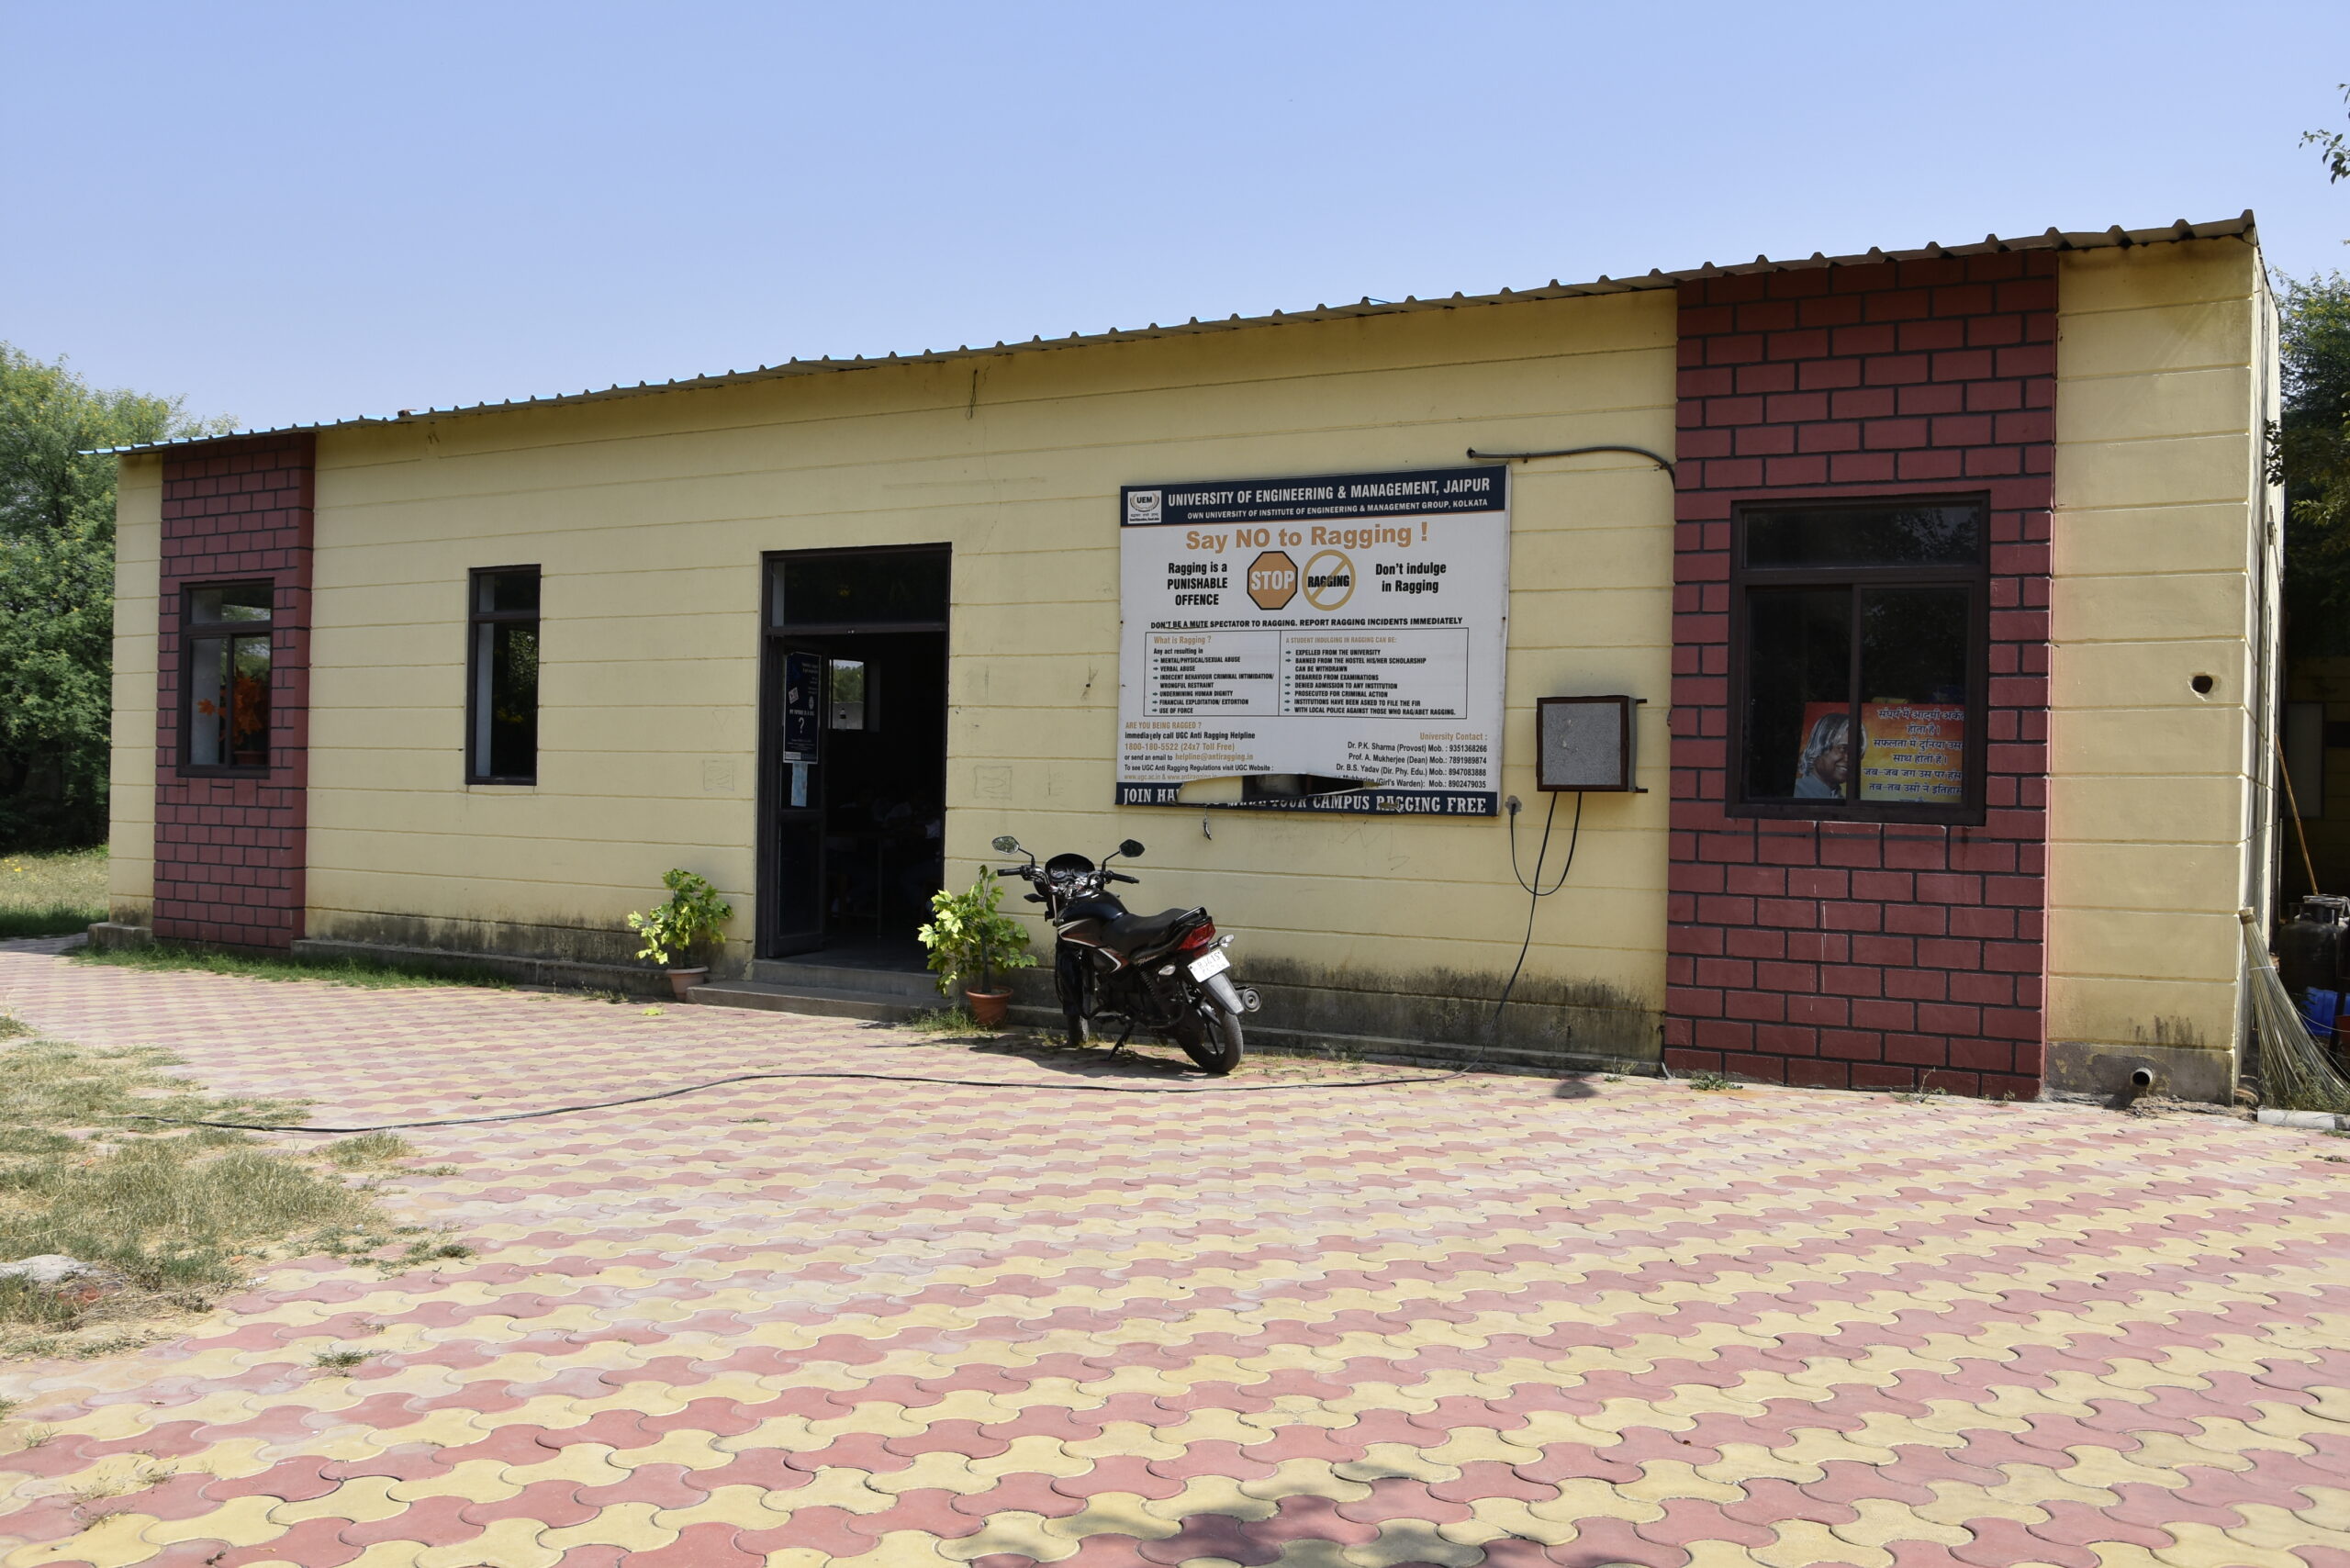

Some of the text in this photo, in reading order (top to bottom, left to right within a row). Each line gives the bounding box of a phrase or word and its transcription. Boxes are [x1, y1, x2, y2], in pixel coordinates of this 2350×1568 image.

[1168, 477, 1490, 507] UNIVERSITY OF ENGINEERING & MANAGEMENT, JAIPUR
[1205, 510, 1247, 519] UNIVERSITY
[1259, 508, 1294, 517] INSTITUTE
[1307, 505, 1358, 515] ENGINEERING
[1367, 502, 1420, 512] MANAGEMENT
[1421, 500, 1451, 510] GROUP,
[1453, 498, 1488, 508] KOLKATA
[1186, 521, 1430, 554] Say NO to Ragging !
[1168, 562, 1228, 576] Ragging is a
[1375, 562, 1447, 576] Don't indulge
[1167, 577, 1228, 590] PUNISHABLE
[1251, 570, 1295, 591] STOP
[1307, 575, 1350, 588] RAGGING
[1381, 579, 1439, 594] in Ragging
[1175, 594, 1219, 606] OFFENCE
[1150, 621, 1172, 629] DON'T
[1172, 620, 1182, 629] BE
[1183, 620, 1189, 628] A
[1189, 620, 1209, 628] MUTE
[1331, 618, 1366, 626] RAGGING
[1367, 618, 1408, 626] INCIDENTS
[1410, 617, 1463, 625] IMMEDIATELY
[1154, 636, 1170, 644] What
[1172, 636, 1178, 644] is
[1179, 636, 1206, 646] Ragging
[1153, 648, 1163, 656] Any
[1139, 721, 1151, 729] YOU
[1152, 721, 1171, 730] BEING
[1203, 731, 1229, 741] Ragging
[1230, 731, 1256, 740] Helpline
[1420, 732, 1454, 741] University
[1455, 732, 1483, 741] Contact
[1125, 742, 1235, 752] 1800-180-5522 (24x7 Toll Free)
[1347, 741, 1357, 749] Dr.
[1358, 741, 1369, 750] P.K.
[1371, 742, 1395, 751] Sharma
[1397, 744, 1426, 753] (Provost)
[1428, 744, 1444, 752] Mob.
[1449, 744, 1488, 753] 9351368266
[1175, 753, 1254, 762] helpline@antiragging.in
[1348, 752, 1363, 761] Prof.
[1373, 754, 1405, 764] Mukherjee
[1407, 756, 1428, 765] (Dean)
[1429, 756, 1447, 764] Mob.:
[1449, 756, 1487, 765] 7891989874
[1166, 764, 1189, 773] Ragging
[1189, 764, 1221, 772] Regulations
[1336, 763, 1487, 777] Dr. B.S. Yadav (Dir. Phy. Edu.) Mob.: 8947083888
[1396, 779, 1425, 789] Warden):
[1429, 780, 1446, 788] Mob.:
[1448, 780, 1486, 789] 8902479035
[1123, 788, 1152, 805] JOIN
[1313, 794, 1370, 810] CAMPUS
[1447, 797, 1486, 814] FREE
